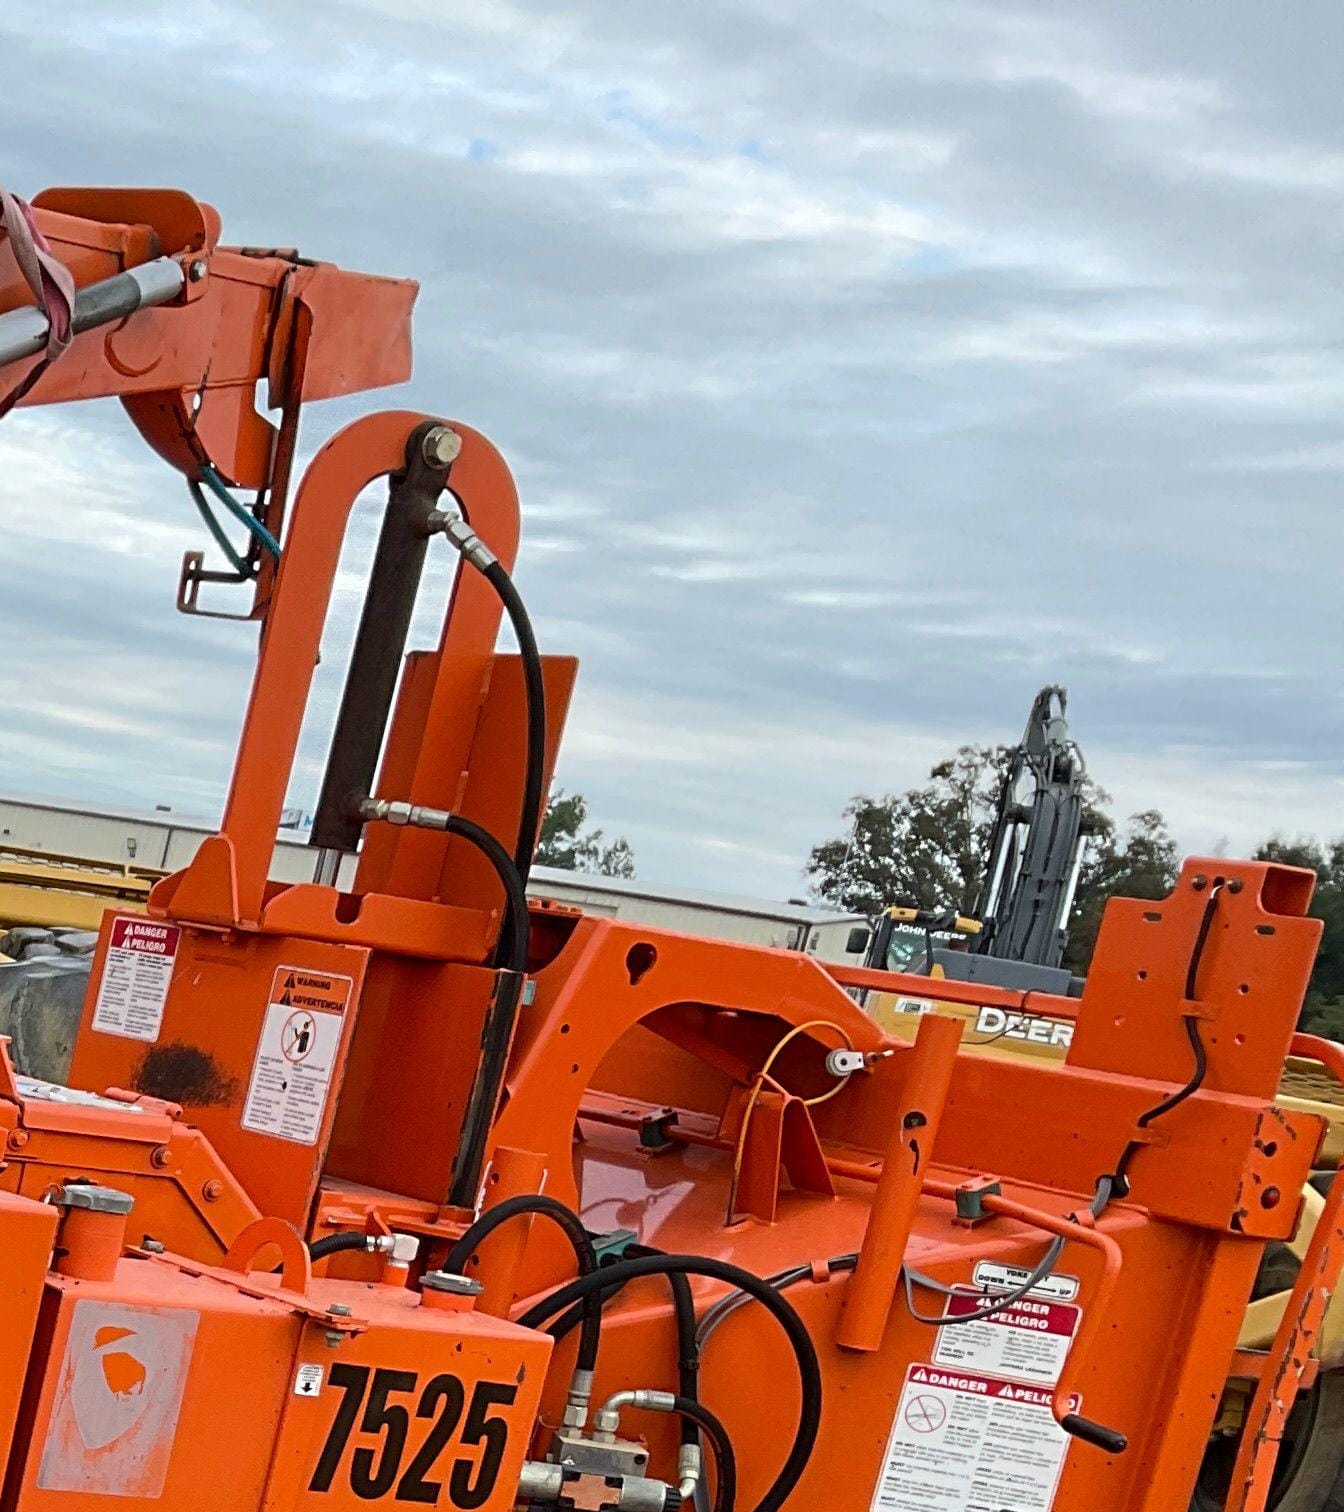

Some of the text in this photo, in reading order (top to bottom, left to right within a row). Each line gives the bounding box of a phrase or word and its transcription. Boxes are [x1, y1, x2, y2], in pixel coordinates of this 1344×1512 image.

[134, 925, 168, 939] DANGER
[894, 922, 927, 936] JOHN
[130, 938, 167, 955] PELIGRO
[297, 975, 331, 992] WARNING
[292, 994, 344, 1013] ADVERTENCIA
[976, 1006, 1075, 1047] DEER
[994, 1297, 1050, 1316] DNGER
[928, 1373, 988, 1394] DANGER
[308, 1362, 519, 1511] 7525
